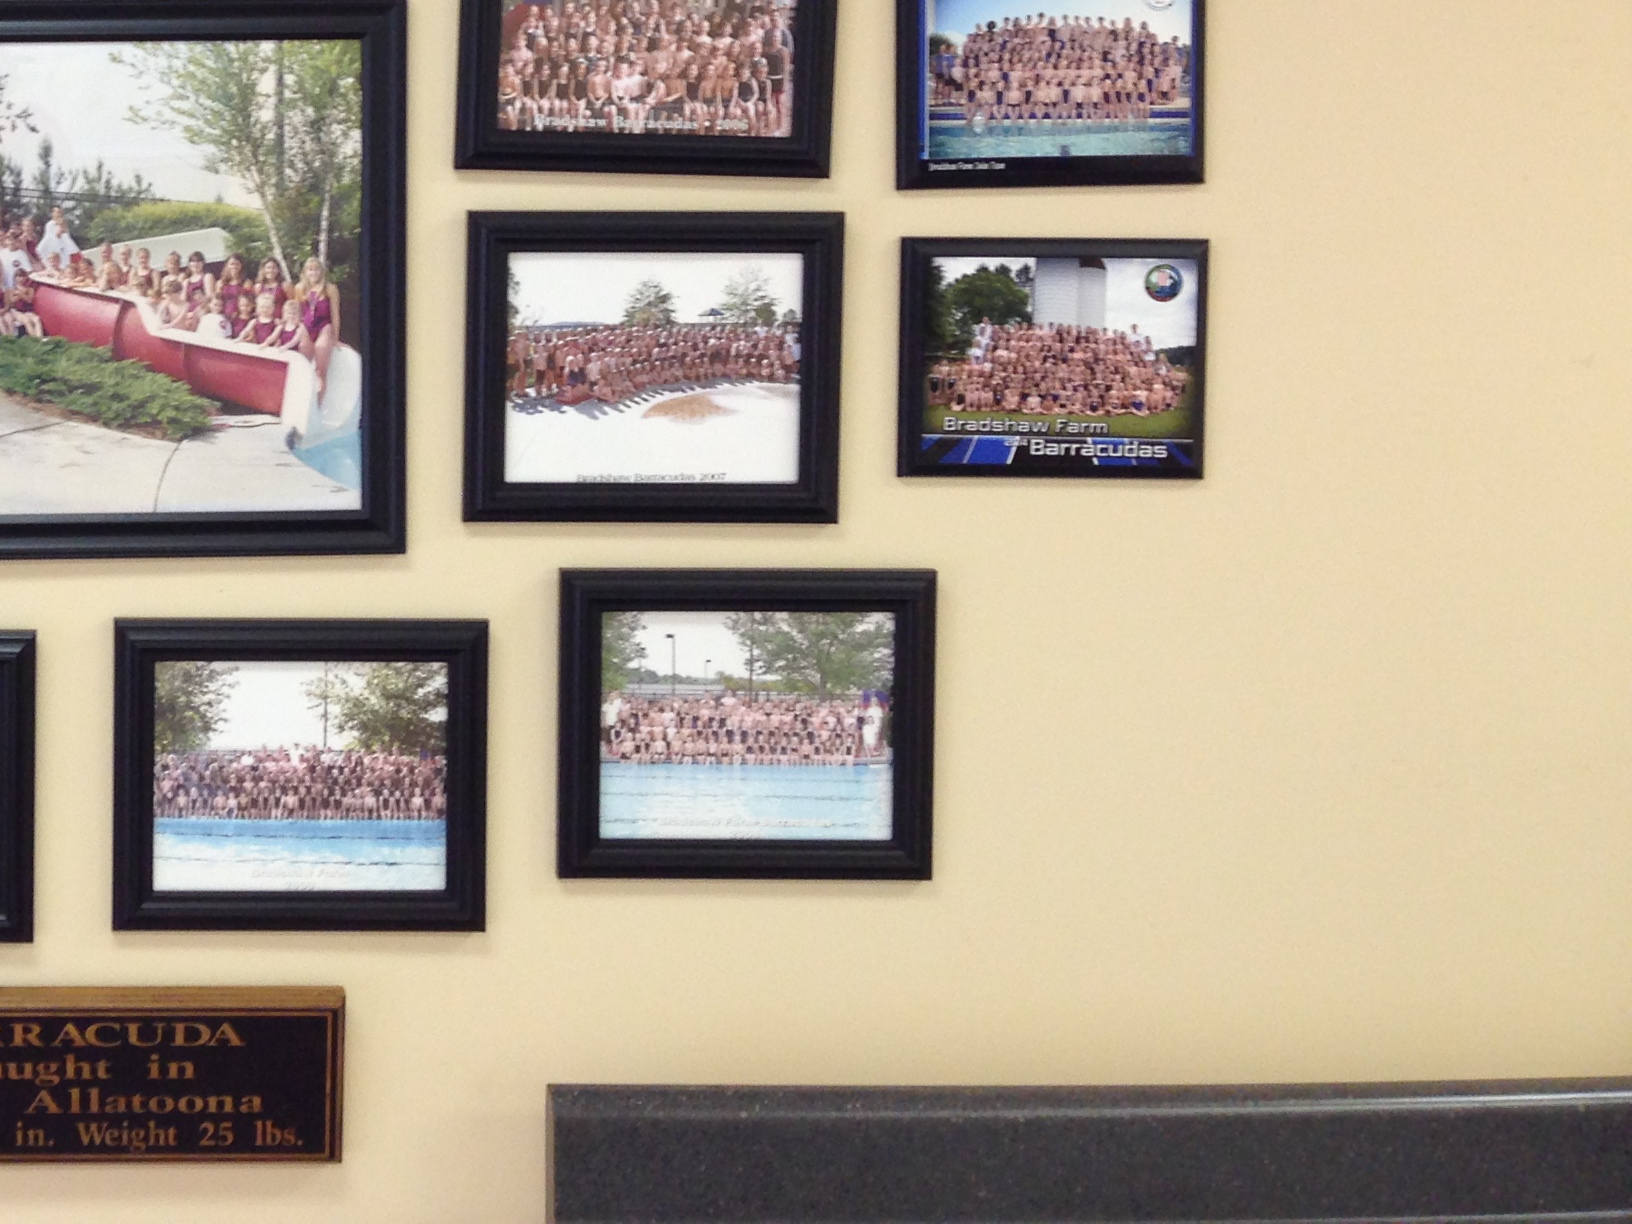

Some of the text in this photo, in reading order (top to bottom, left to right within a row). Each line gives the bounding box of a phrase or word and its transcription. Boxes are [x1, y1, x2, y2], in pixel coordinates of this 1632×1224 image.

[941, 416, 1109, 434] Bradshaw Farm
[1028, 438, 1169, 459] Barracudas
[147, 1053, 196, 1079] in
[24, 1086, 265, 1114] Allatoona
[15, 1122, 55, 1147] in.
[77, 1122, 178, 1151] Weight
[198, 1122, 234, 1147] 25
[254, 1120, 304, 1147] lbs.
